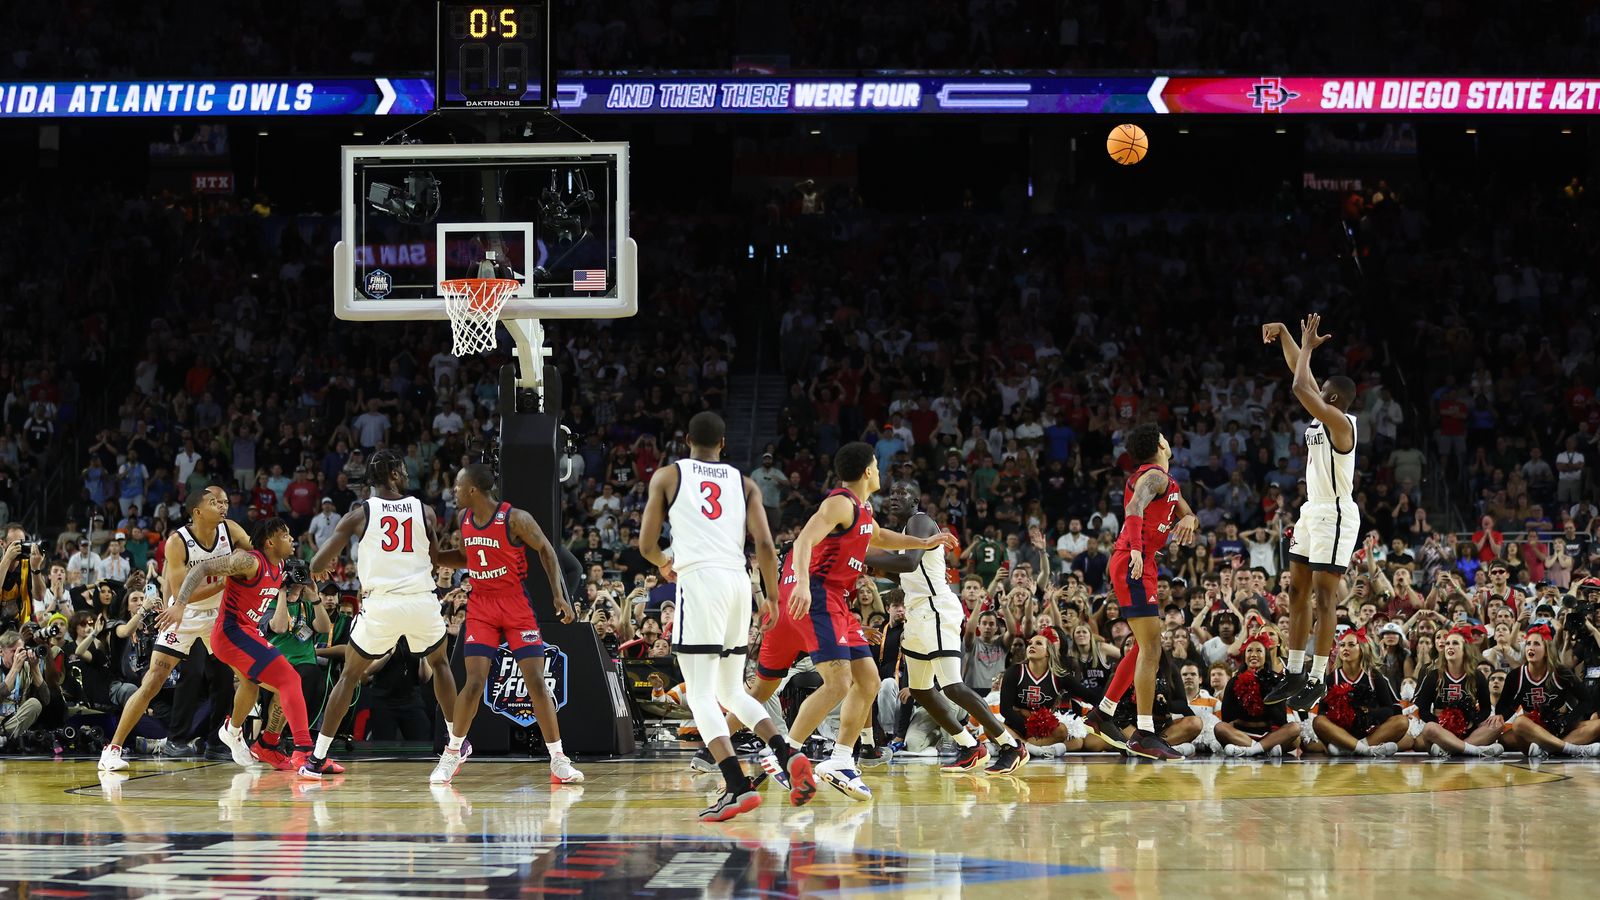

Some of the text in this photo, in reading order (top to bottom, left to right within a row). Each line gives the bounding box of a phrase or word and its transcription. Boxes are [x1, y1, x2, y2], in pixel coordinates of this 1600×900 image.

[68, 84, 216, 112] ATLANTIC
[227, 82, 314, 111] OWLS
[606, 82, 921, 108] AND THEN THERE WERE FOUR
[1320, 80, 1600, 110] SAN DIEGO STATE AZT
[195, 176, 229, 189] HTX
[370, 276, 388, 284] FINAL
[371, 283, 389, 291] FOUR
[692, 462, 729, 479] PARRISH
[382, 502, 413, 513] MENSAH
[700, 480, 723, 521] 3
[380, 515, 415, 553] 31
[464, 536, 500, 549] FLORIDA
[477, 549, 488, 567] 1
[984, 547, 995, 563] 3
